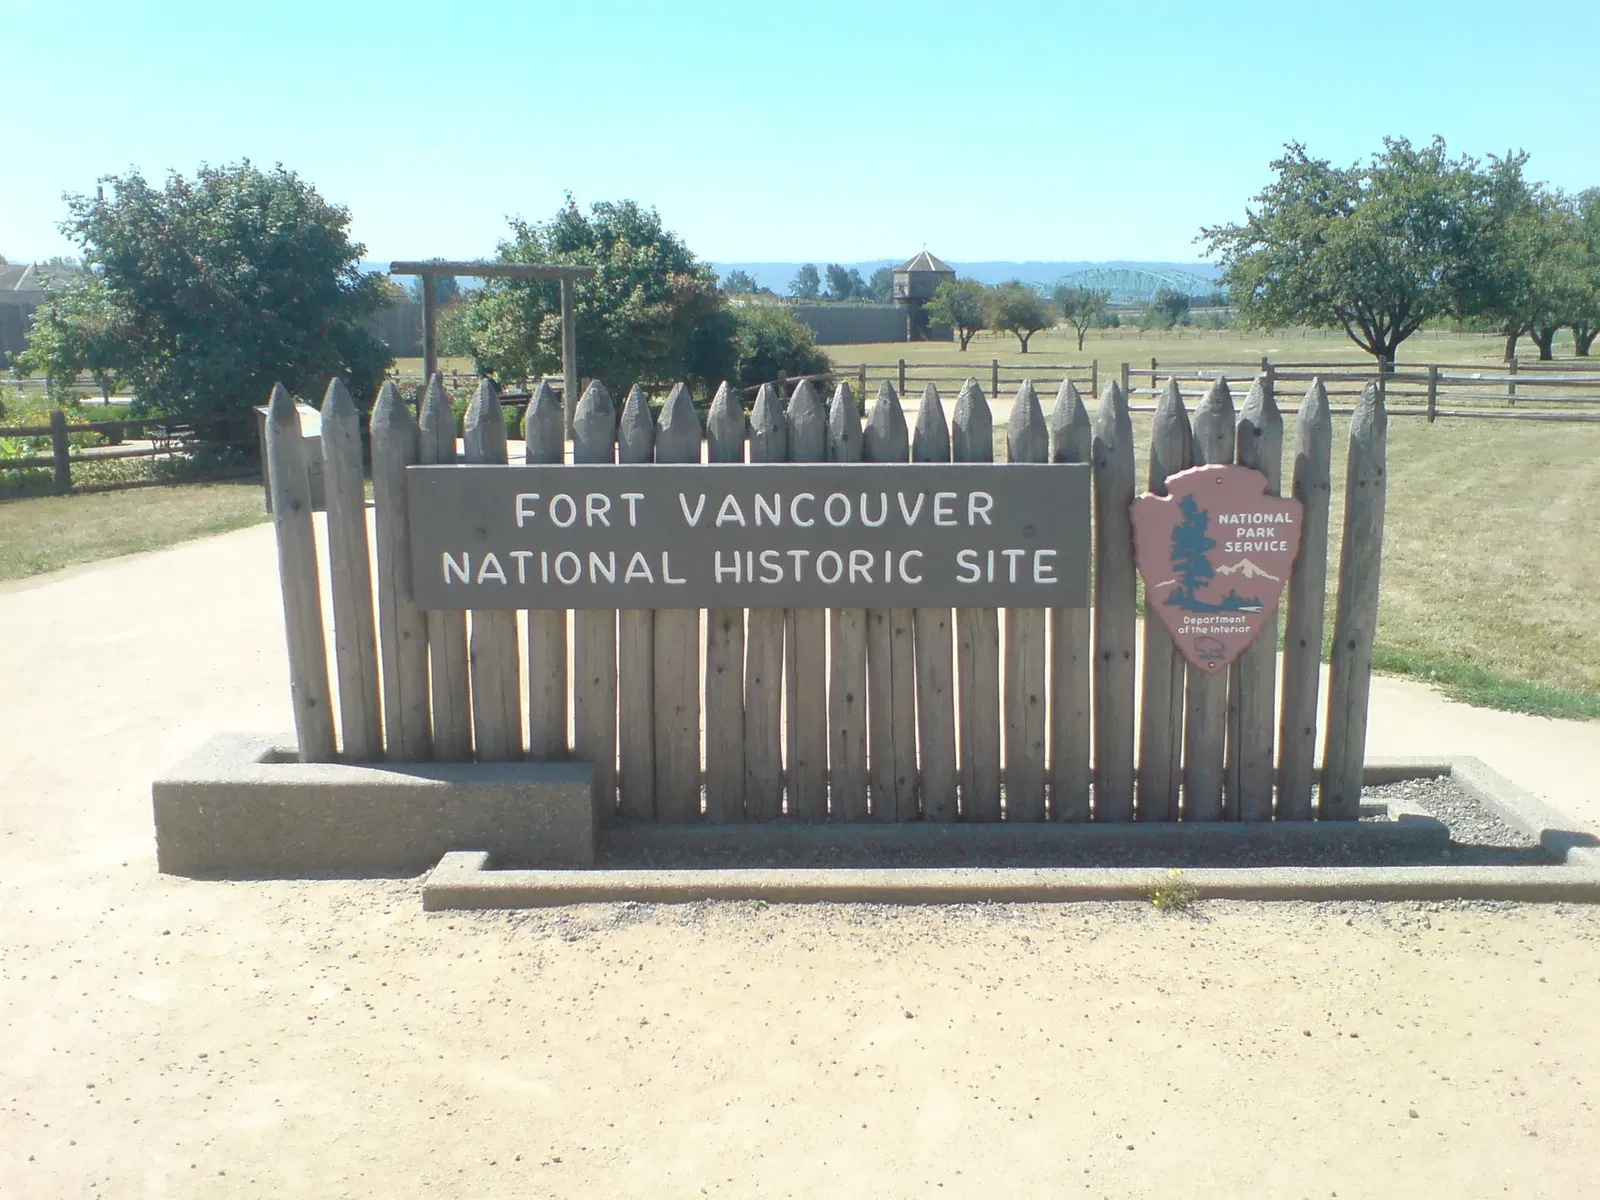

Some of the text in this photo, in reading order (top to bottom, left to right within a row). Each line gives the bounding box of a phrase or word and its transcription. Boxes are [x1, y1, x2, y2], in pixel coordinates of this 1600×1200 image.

[515, 491, 994, 528] FORT VANCOUVER
[1218, 512, 1293, 525] NATIONAL
[1236, 527, 1275, 538] PARK
[1224, 540, 1288, 552] SERVICE
[442, 549, 1058, 585] NATIONAL HISTORIC SITE
[1183, 615, 1246, 626] Department
[1178, 624, 1251, 634] of the Interior
